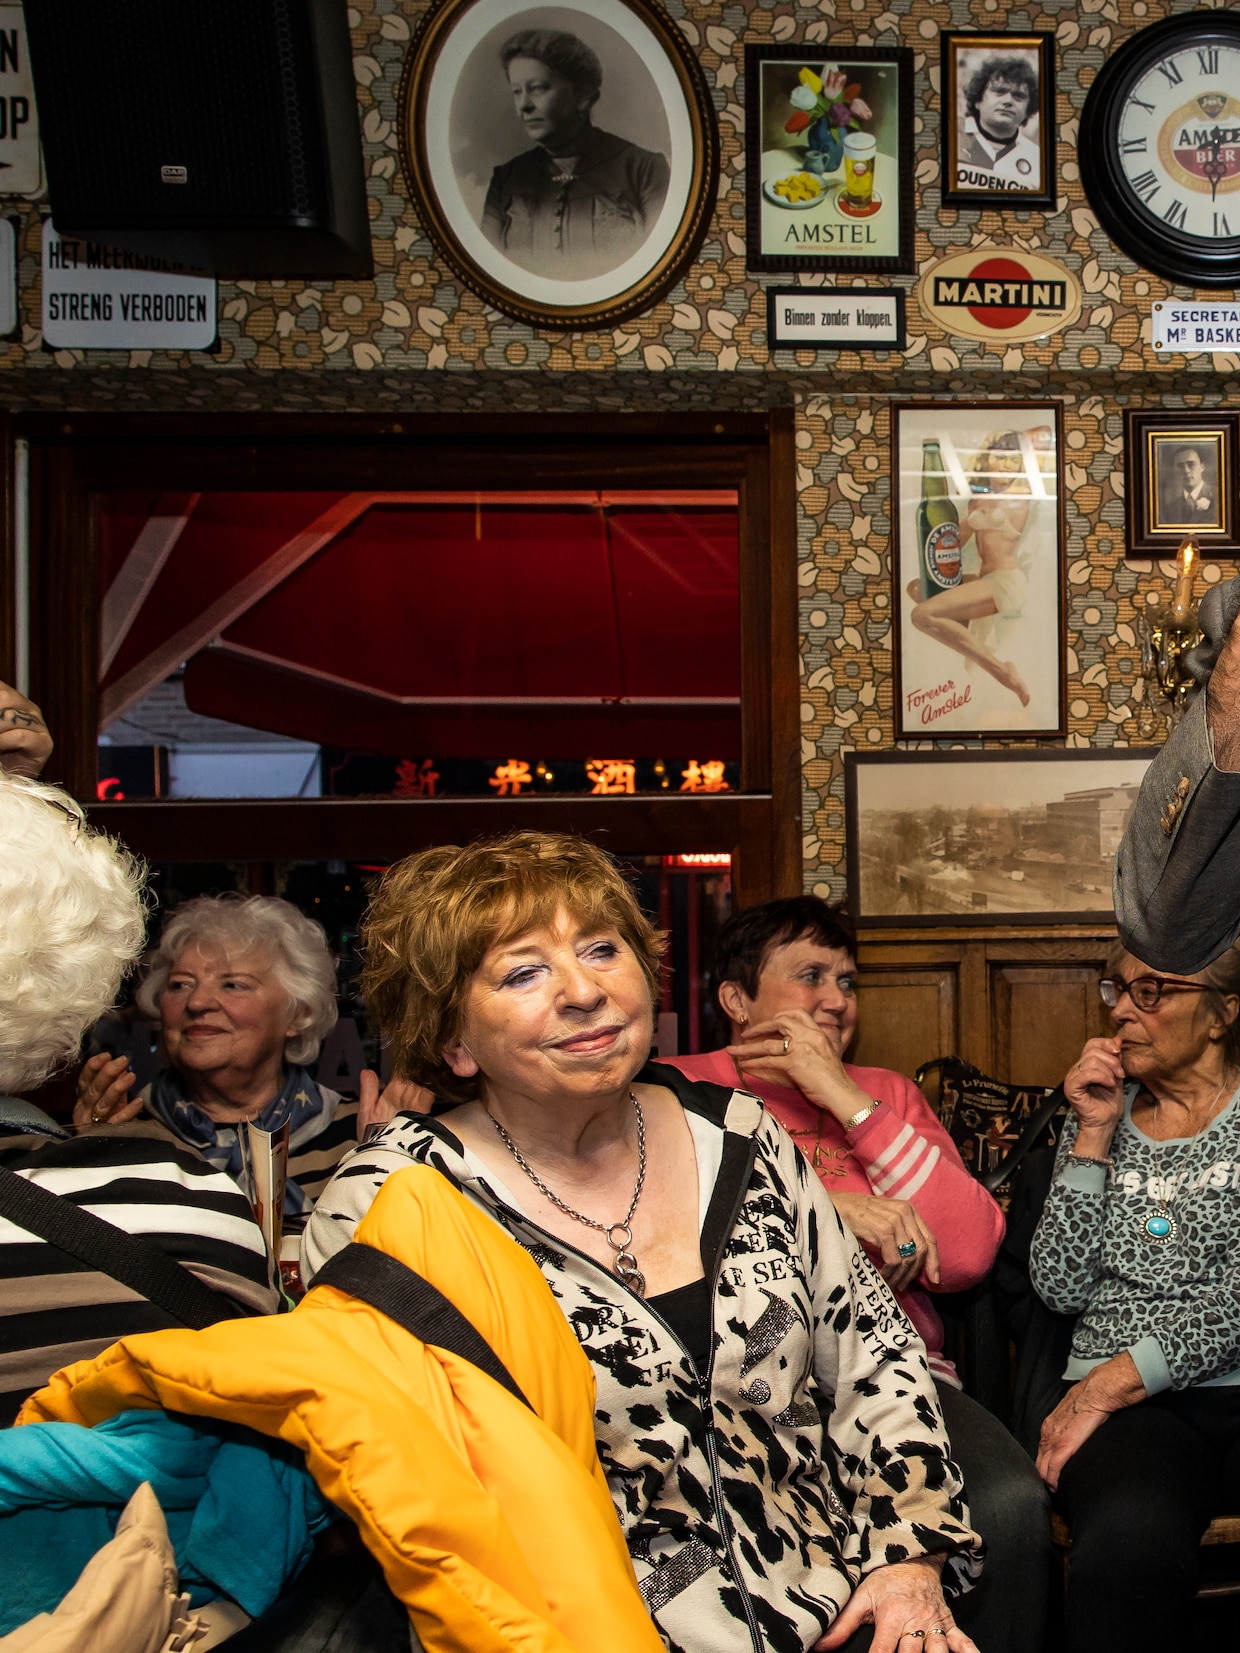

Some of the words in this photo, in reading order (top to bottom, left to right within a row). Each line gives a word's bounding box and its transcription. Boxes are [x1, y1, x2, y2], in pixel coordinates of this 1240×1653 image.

[1197, 50, 1219, 75] XII
[784, 223, 878, 244] AMSTEL
[938, 280, 1062, 306] MARTINI
[49, 293, 112, 321] STRENG
[119, 293, 207, 323] VERBODEN
[784, 308, 815, 326] Binnen
[821, 308, 850, 326] zonder
[856, 308, 893, 329] kloppen.
[906, 679, 956, 713] Forever
[921, 684, 973, 725] Amstel
